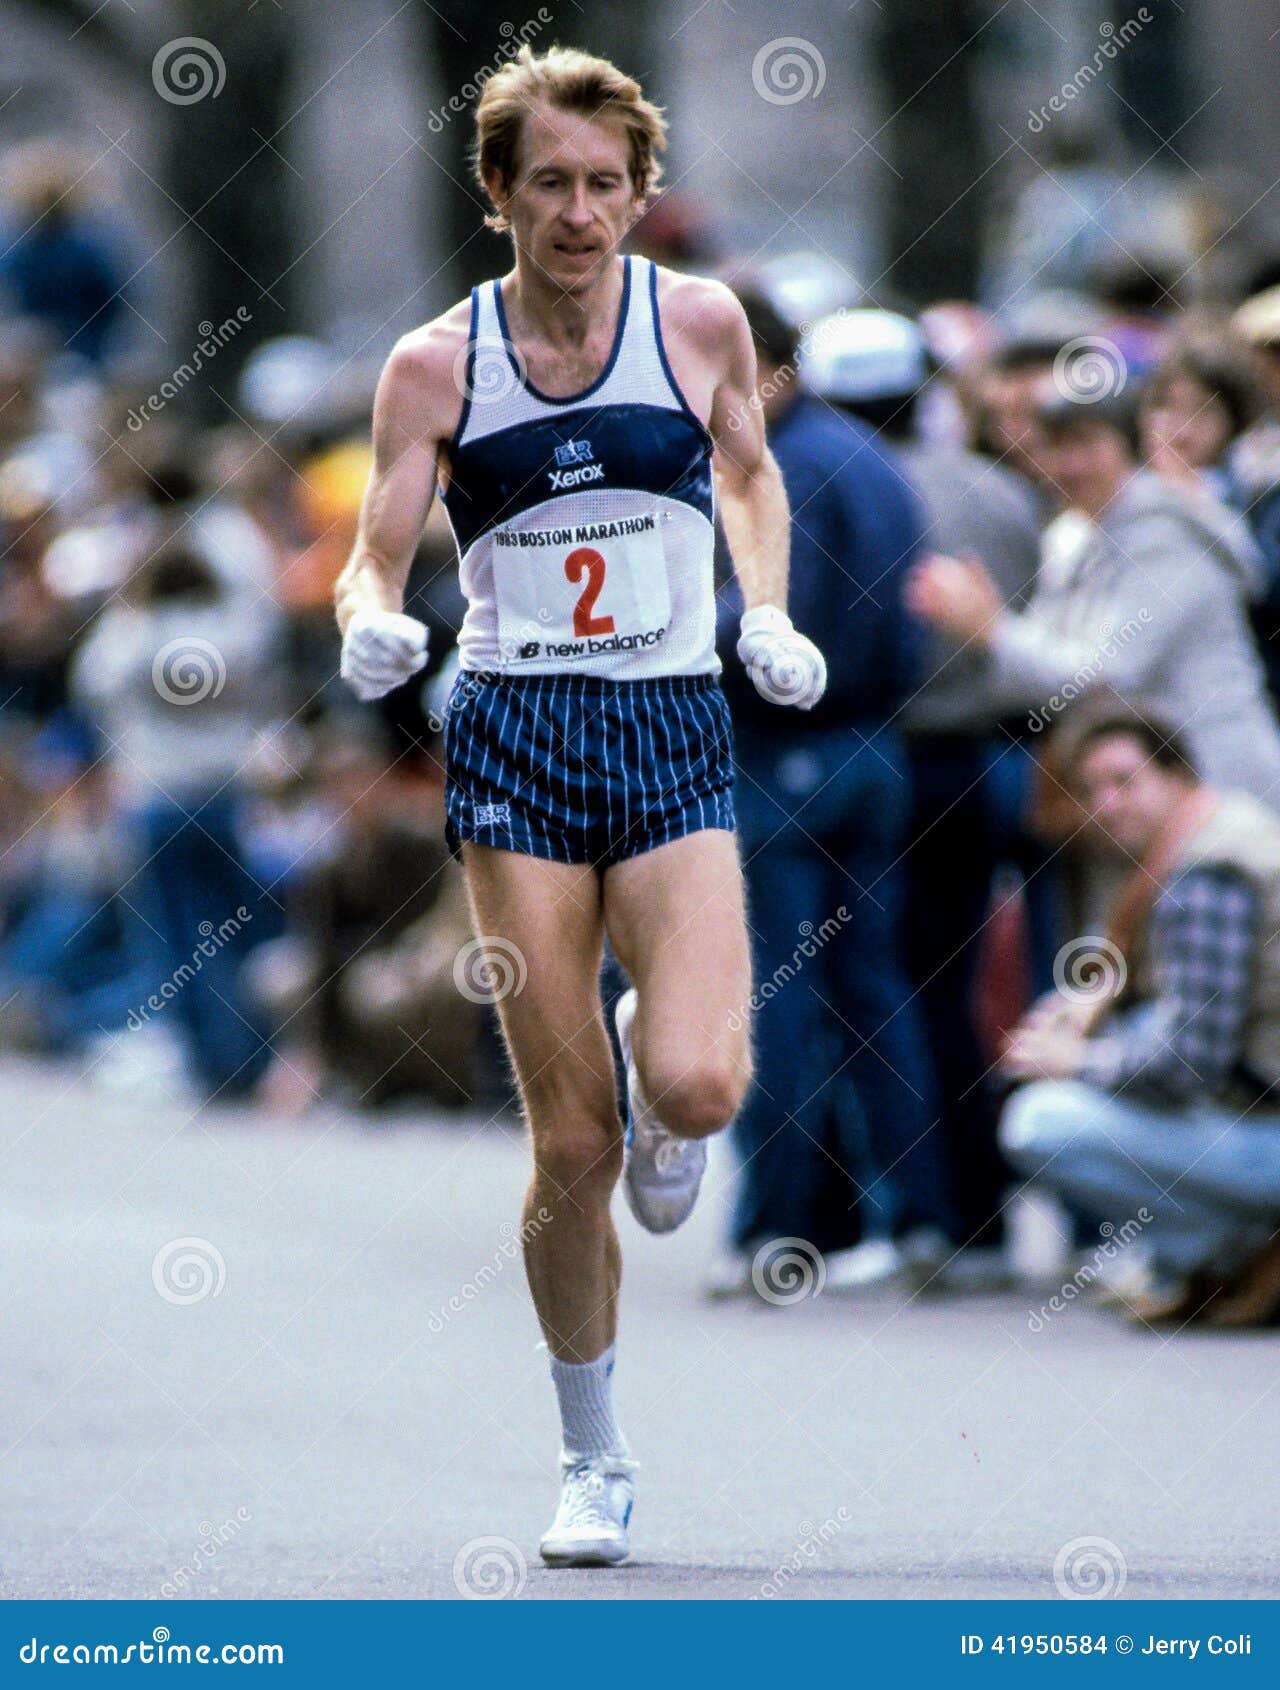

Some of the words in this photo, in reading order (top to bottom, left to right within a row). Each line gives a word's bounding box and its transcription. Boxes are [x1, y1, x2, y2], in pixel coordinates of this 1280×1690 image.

[547, 463, 605, 491] Xerox
[519, 528, 573, 547] BOSTON
[575, 515, 656, 543] MARATHON
[564, 546, 616, 638] 2
[545, 643, 585, 657] new
[587, 627, 665, 654] balance
